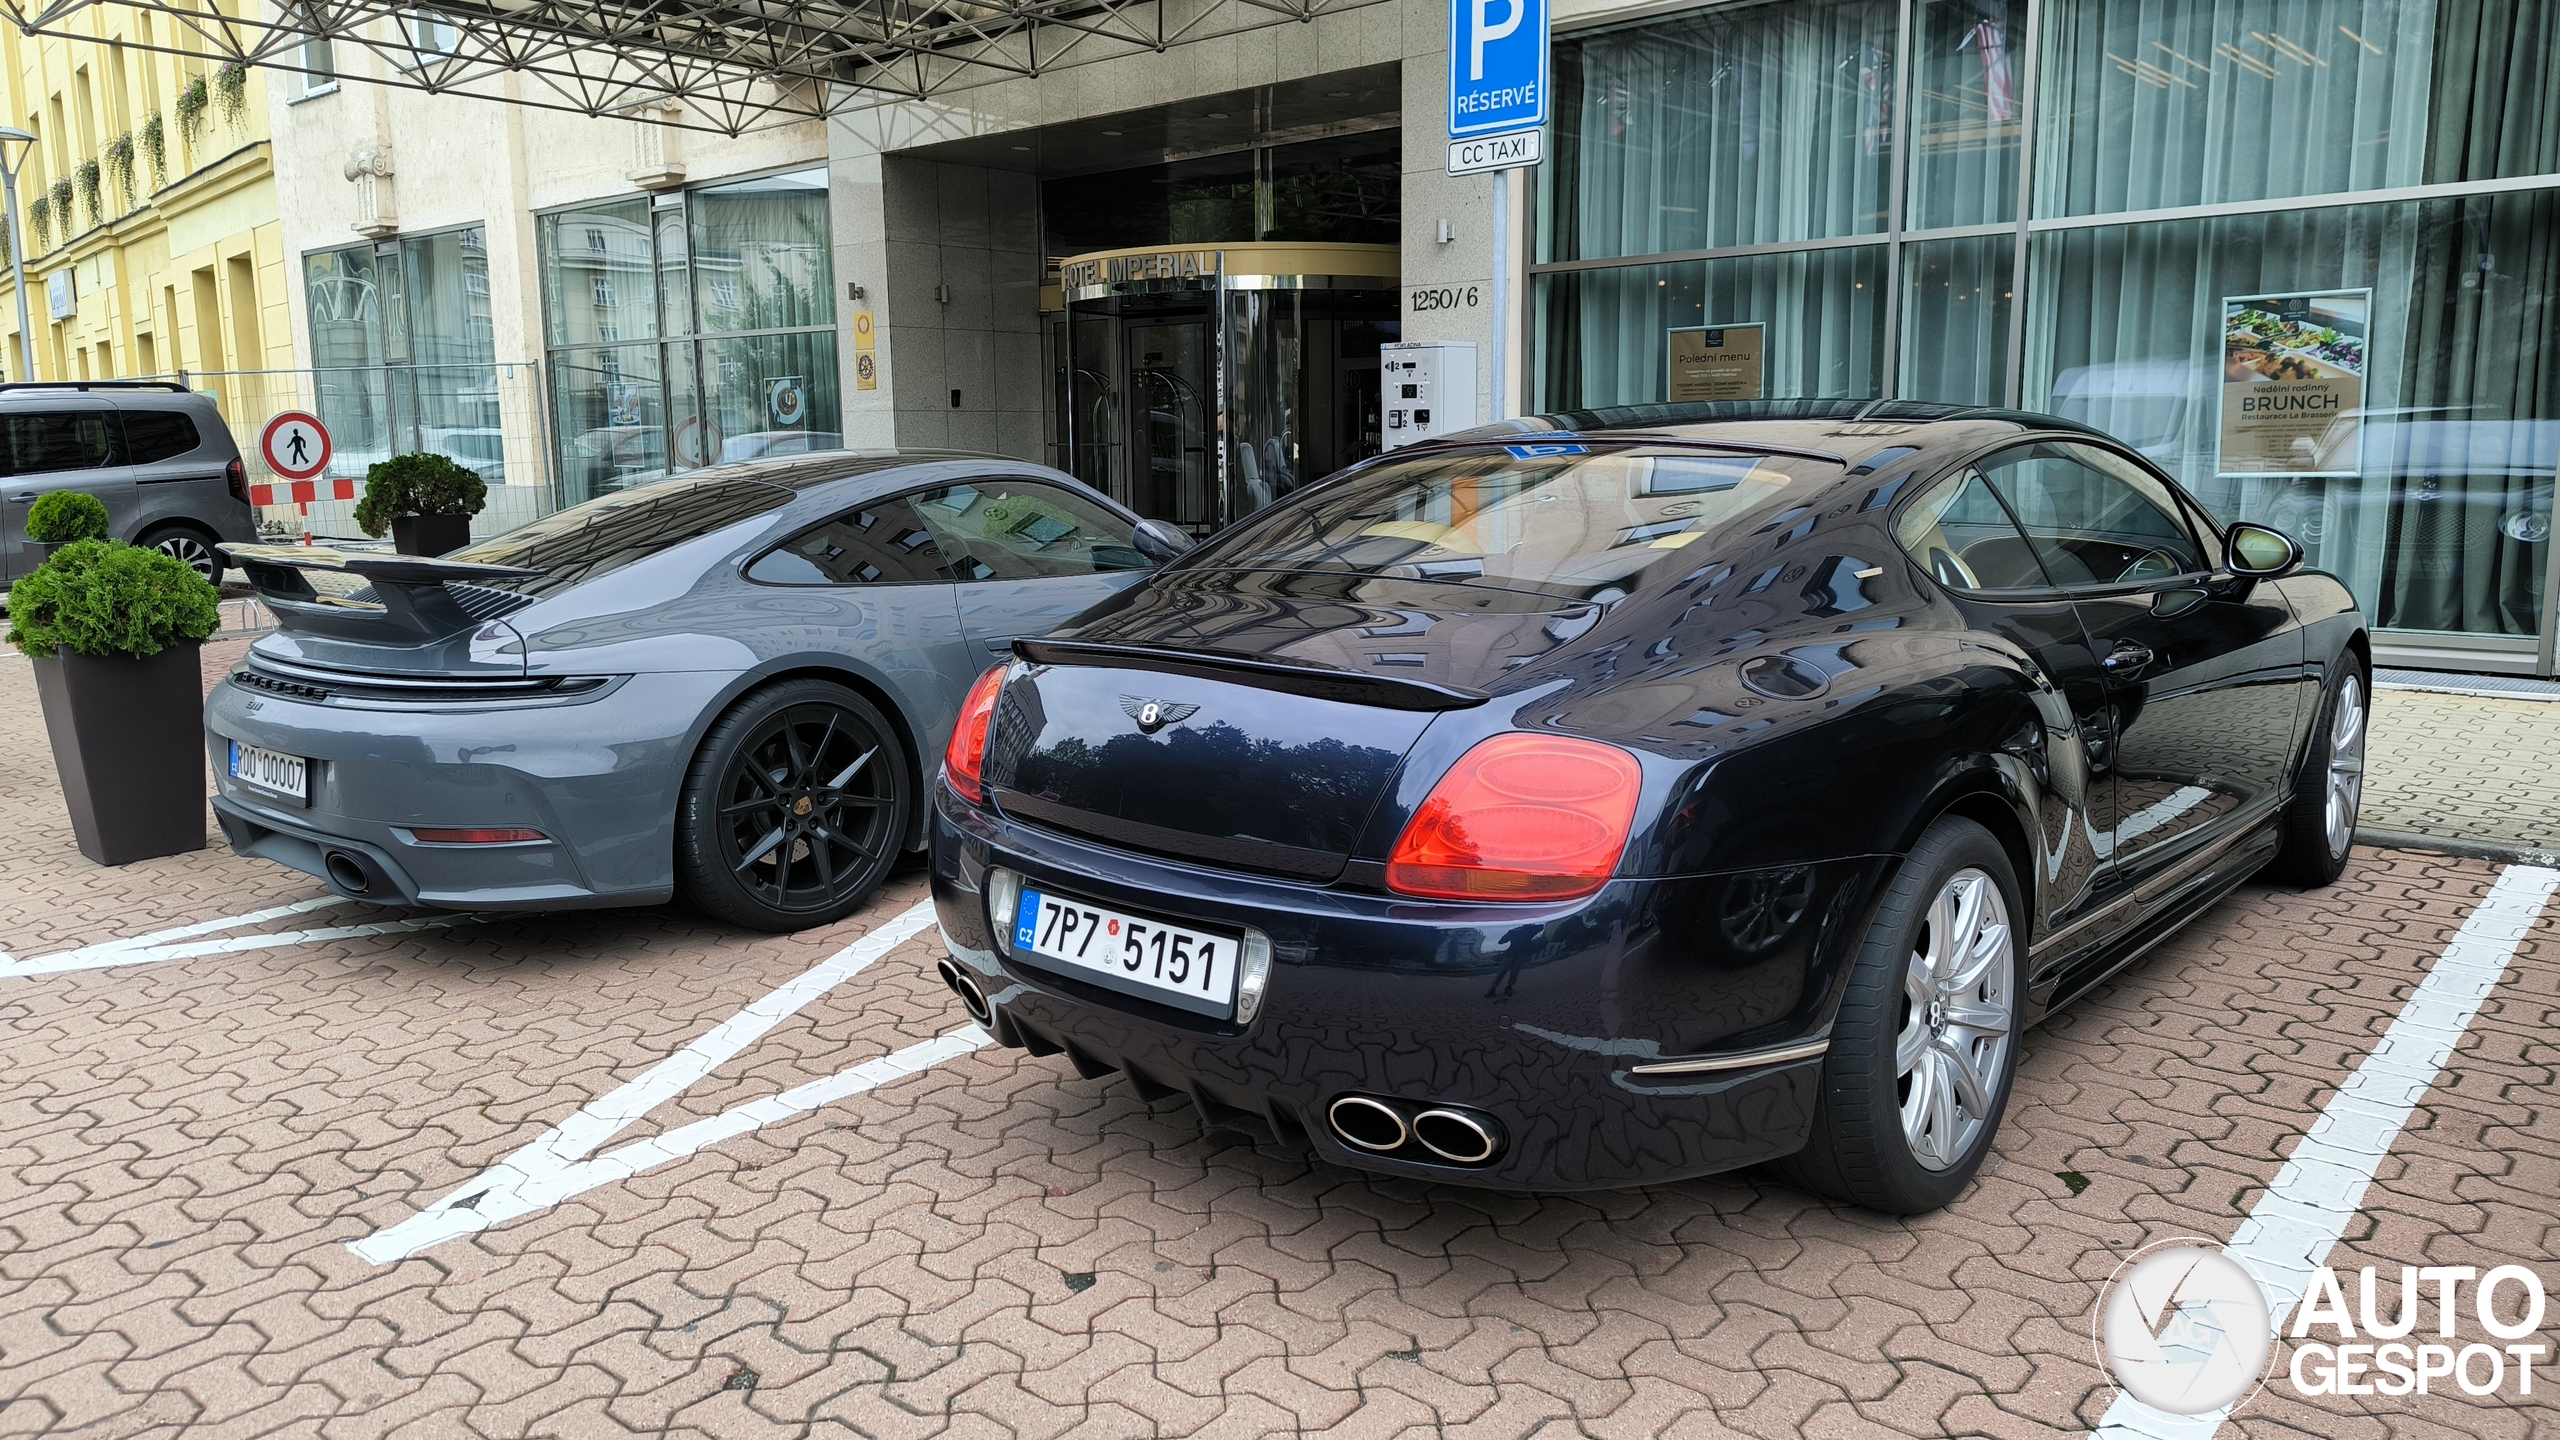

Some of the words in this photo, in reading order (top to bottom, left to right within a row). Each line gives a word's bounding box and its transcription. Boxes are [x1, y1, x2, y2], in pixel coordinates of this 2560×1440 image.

[1471, 0, 1525, 81] P
[1457, 80, 1536, 115] RÉSERVÉ
[1462, 144, 1484, 165] CC
[1488, 137, 1526, 161] TAXI
[1063, 260, 1105, 290] HOTEL
[1106, 251, 1216, 283] IMPERIAL
[1679, 352, 1718, 364] Polední
[1719, 353, 1751, 362] menu
[2253, 384, 2291, 394] Nedělní
[2292, 383, 2330, 393] rodinný
[2242, 394, 2339, 412] BRUNCH
[2241, 412, 2288, 421] Restaurace
[2289, 412, 2299, 420] La
[1019, 927, 1033, 944] CZ
[1040, 902, 1101, 958] 7P7
[1122, 922, 1216, 991] 5151
